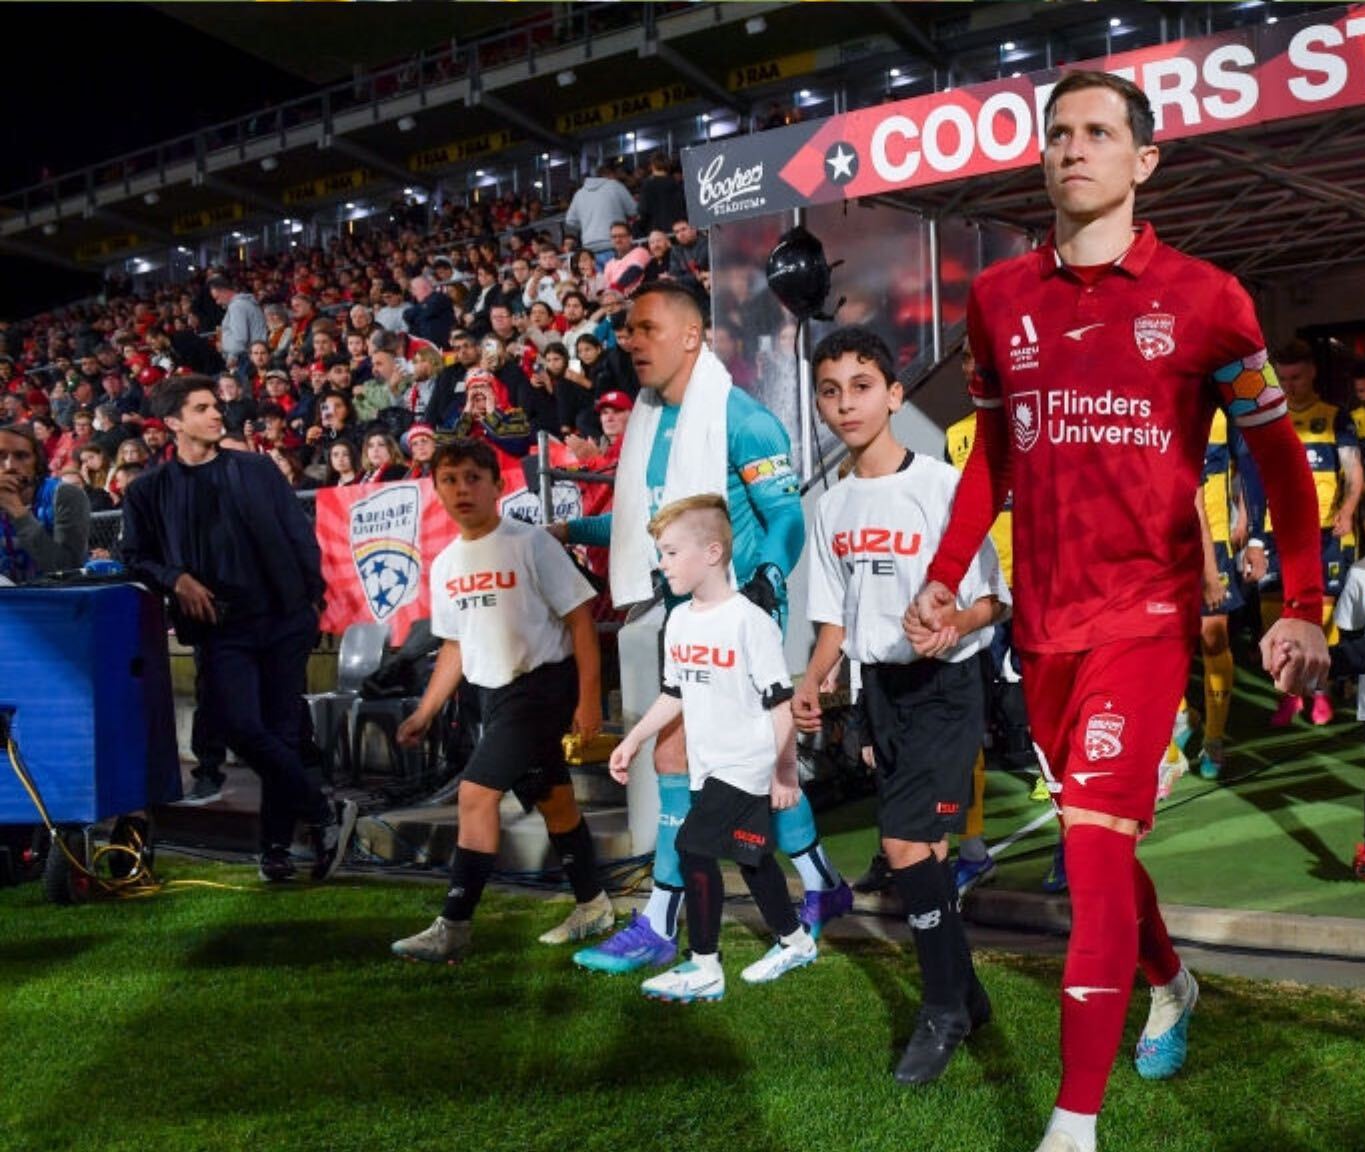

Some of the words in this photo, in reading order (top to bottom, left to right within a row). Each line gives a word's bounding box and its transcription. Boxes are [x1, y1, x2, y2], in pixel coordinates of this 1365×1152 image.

[871, 43, 1259, 183] COORS
[1048, 389, 1152, 418] Flinders
[1047, 419, 1172, 454] University
[508, 501, 575, 521] ADELDE
[446, 569, 516, 598] SUZU
